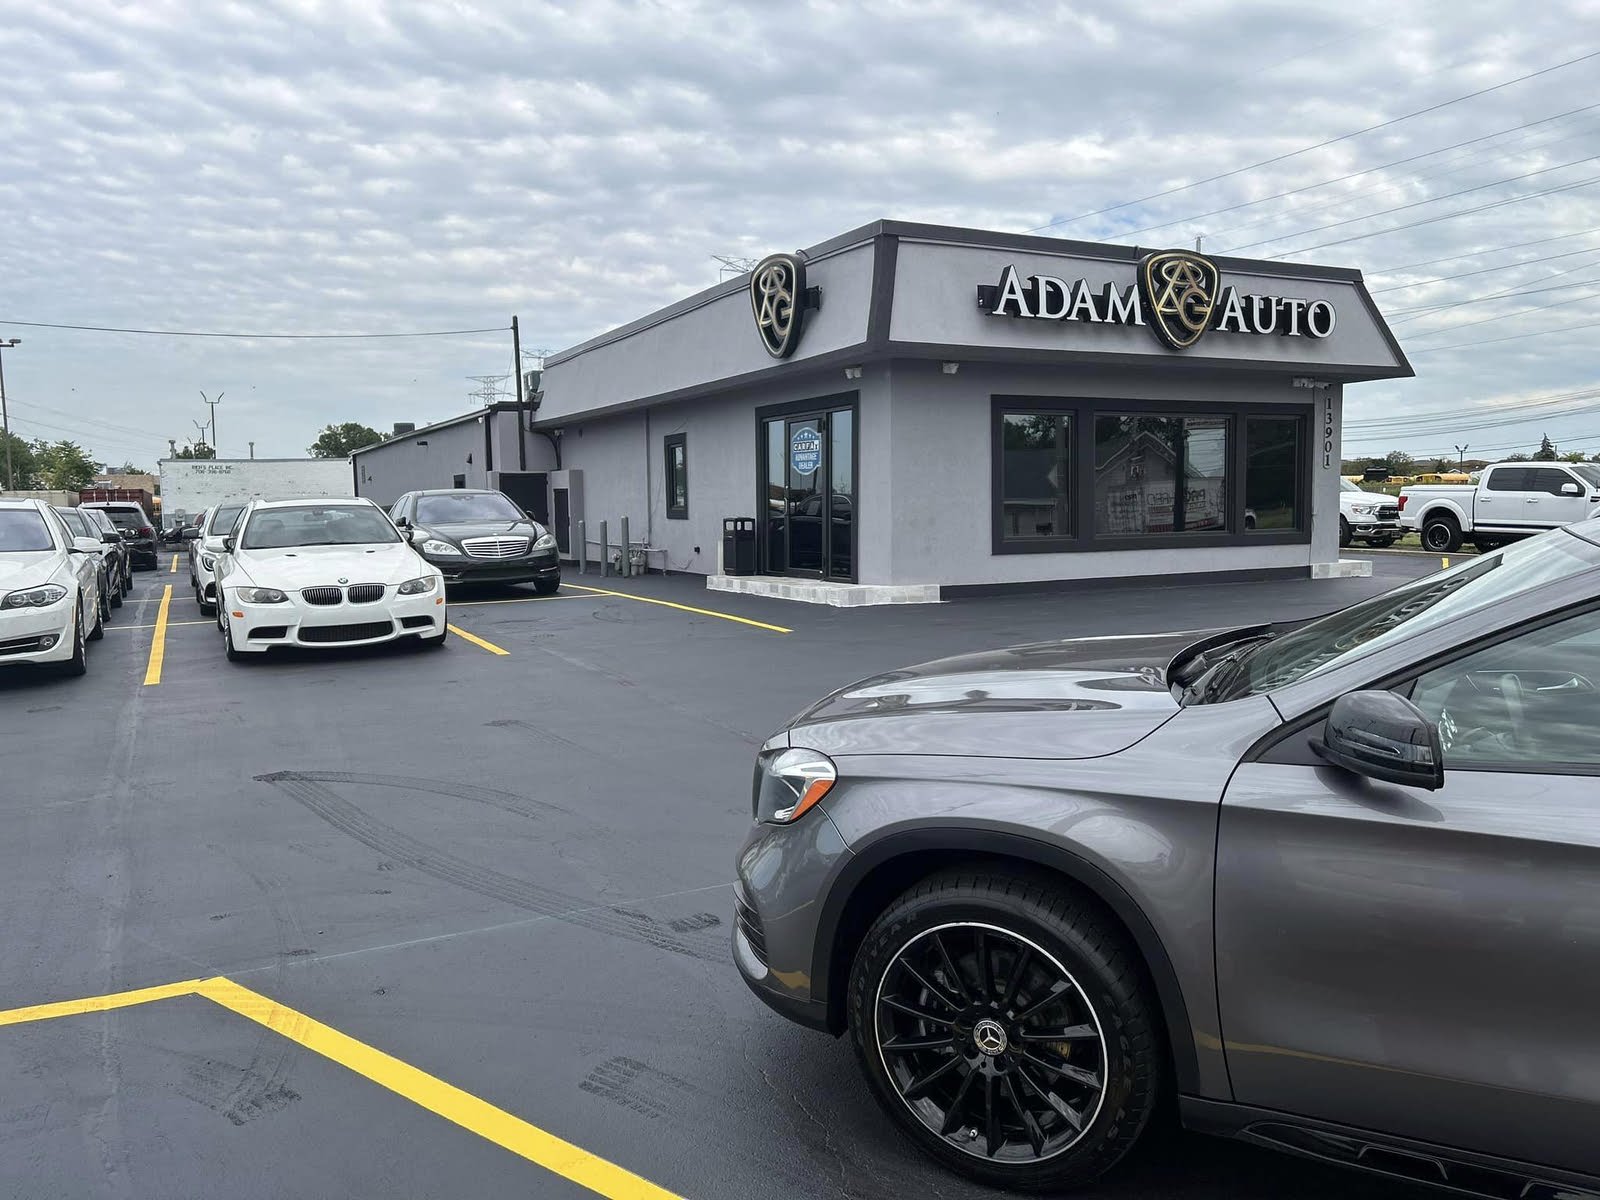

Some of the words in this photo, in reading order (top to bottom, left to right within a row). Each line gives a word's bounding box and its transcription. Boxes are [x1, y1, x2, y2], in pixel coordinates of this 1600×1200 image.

[992, 264, 1146, 326] ADAM
[1216, 285, 1336, 339] AUTO
[1324, 398, 1333, 466] 13901
